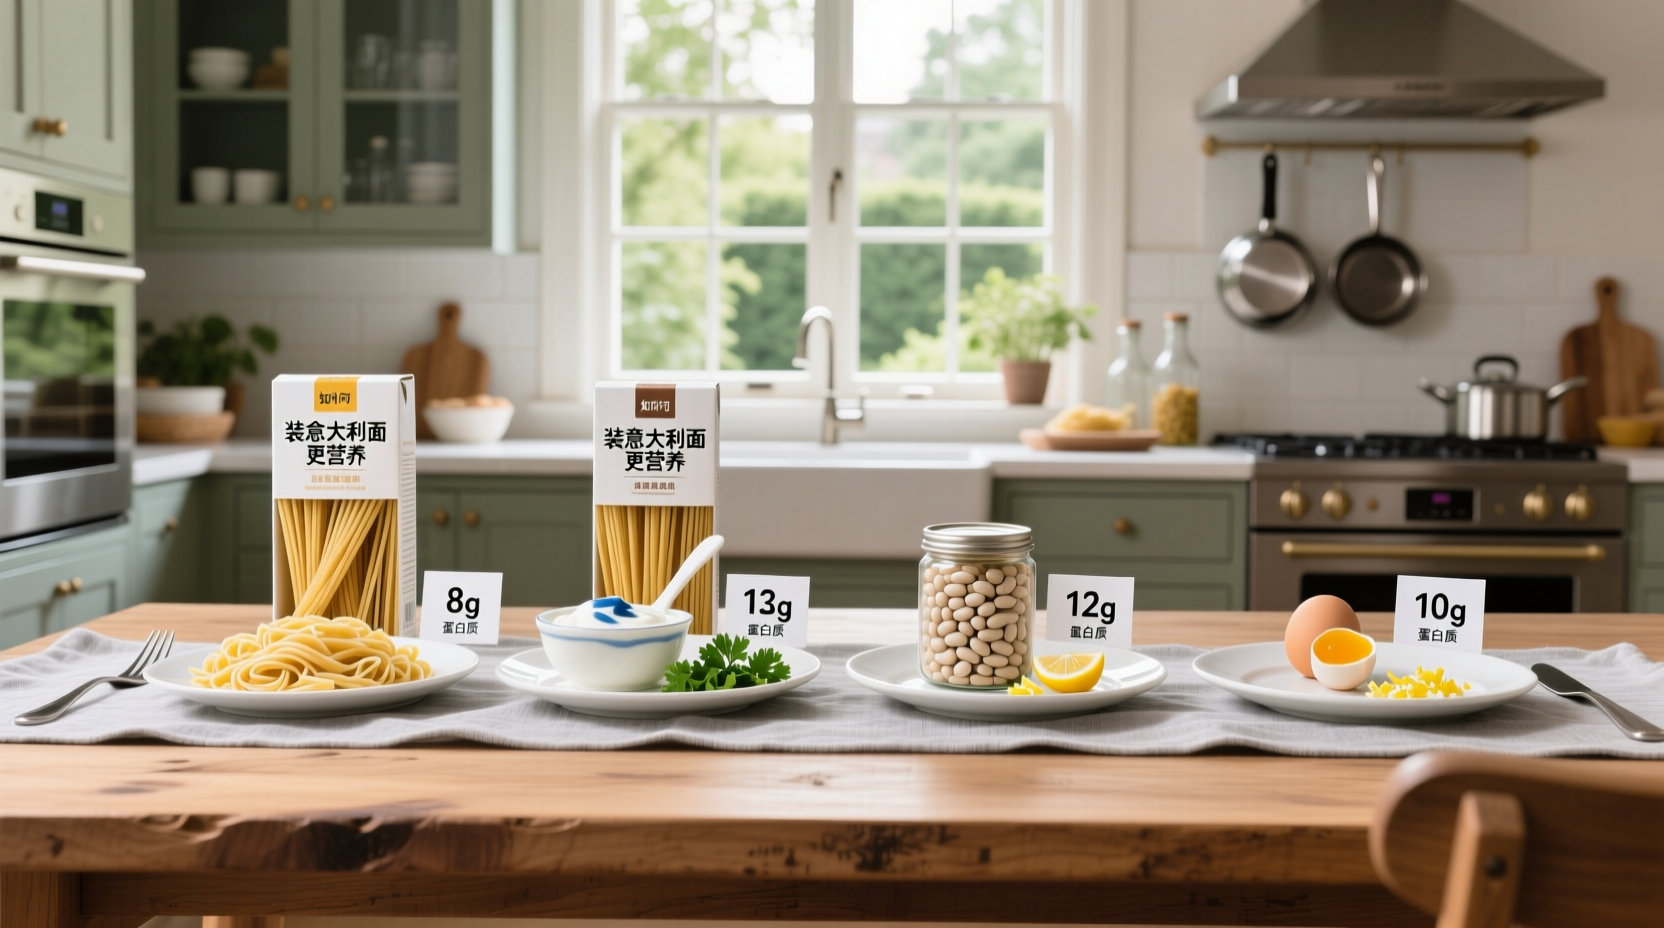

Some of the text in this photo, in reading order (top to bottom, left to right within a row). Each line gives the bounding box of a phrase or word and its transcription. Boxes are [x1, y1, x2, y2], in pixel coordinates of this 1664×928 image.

[604, 427, 706, 450] 装意大利面
[306, 443, 366, 466] 更营养
[625, 449, 686, 472] 更营养
[446, 586, 480, 620] 8g
[744, 588, 792, 623] 13g
[1066, 590, 1116, 625] 12g
[1415, 592, 1466, 628] 10g
[442, 621, 479, 635] 蛋白质
[747, 623, 785, 638] 蛋白质
[1417, 627, 1458, 644] 蛋白质
